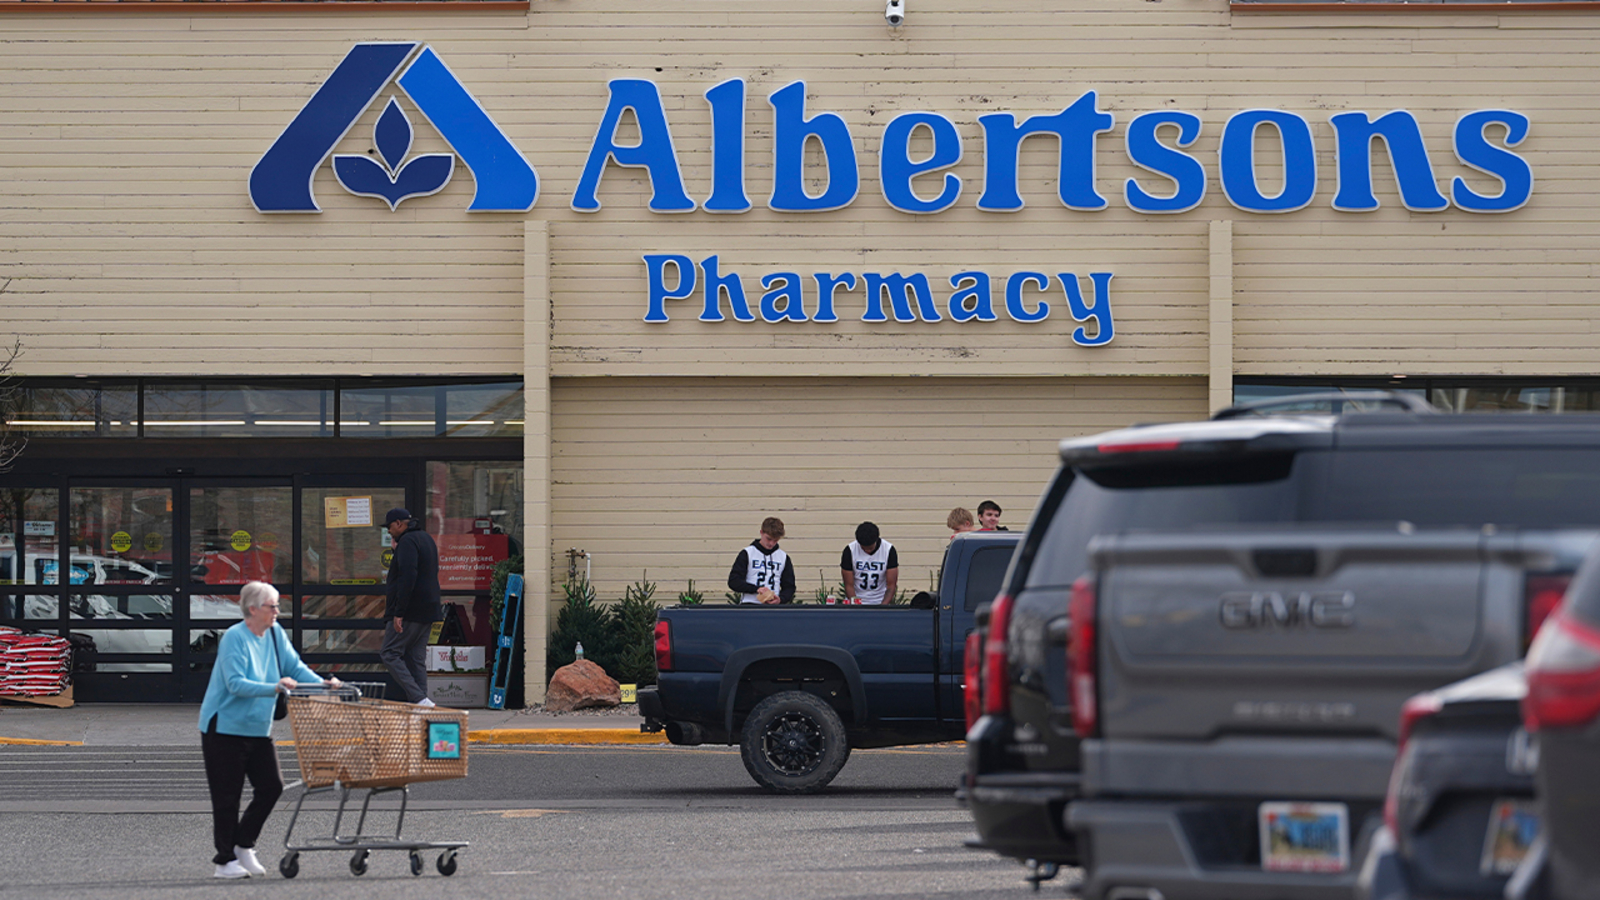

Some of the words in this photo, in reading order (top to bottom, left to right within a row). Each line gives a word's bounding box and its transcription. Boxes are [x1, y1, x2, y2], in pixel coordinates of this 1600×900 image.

[571, 78, 1533, 214] Albertsons
[642, 253, 1115, 347] Pharmacy
[439, 555, 469, 563] Carefully
[752, 559, 781, 571] EAST
[856, 561, 886, 571] EAST
[756, 571, 776, 591] 24
[859, 572, 880, 590] 33
[1218, 590, 1355, 630] GMC
